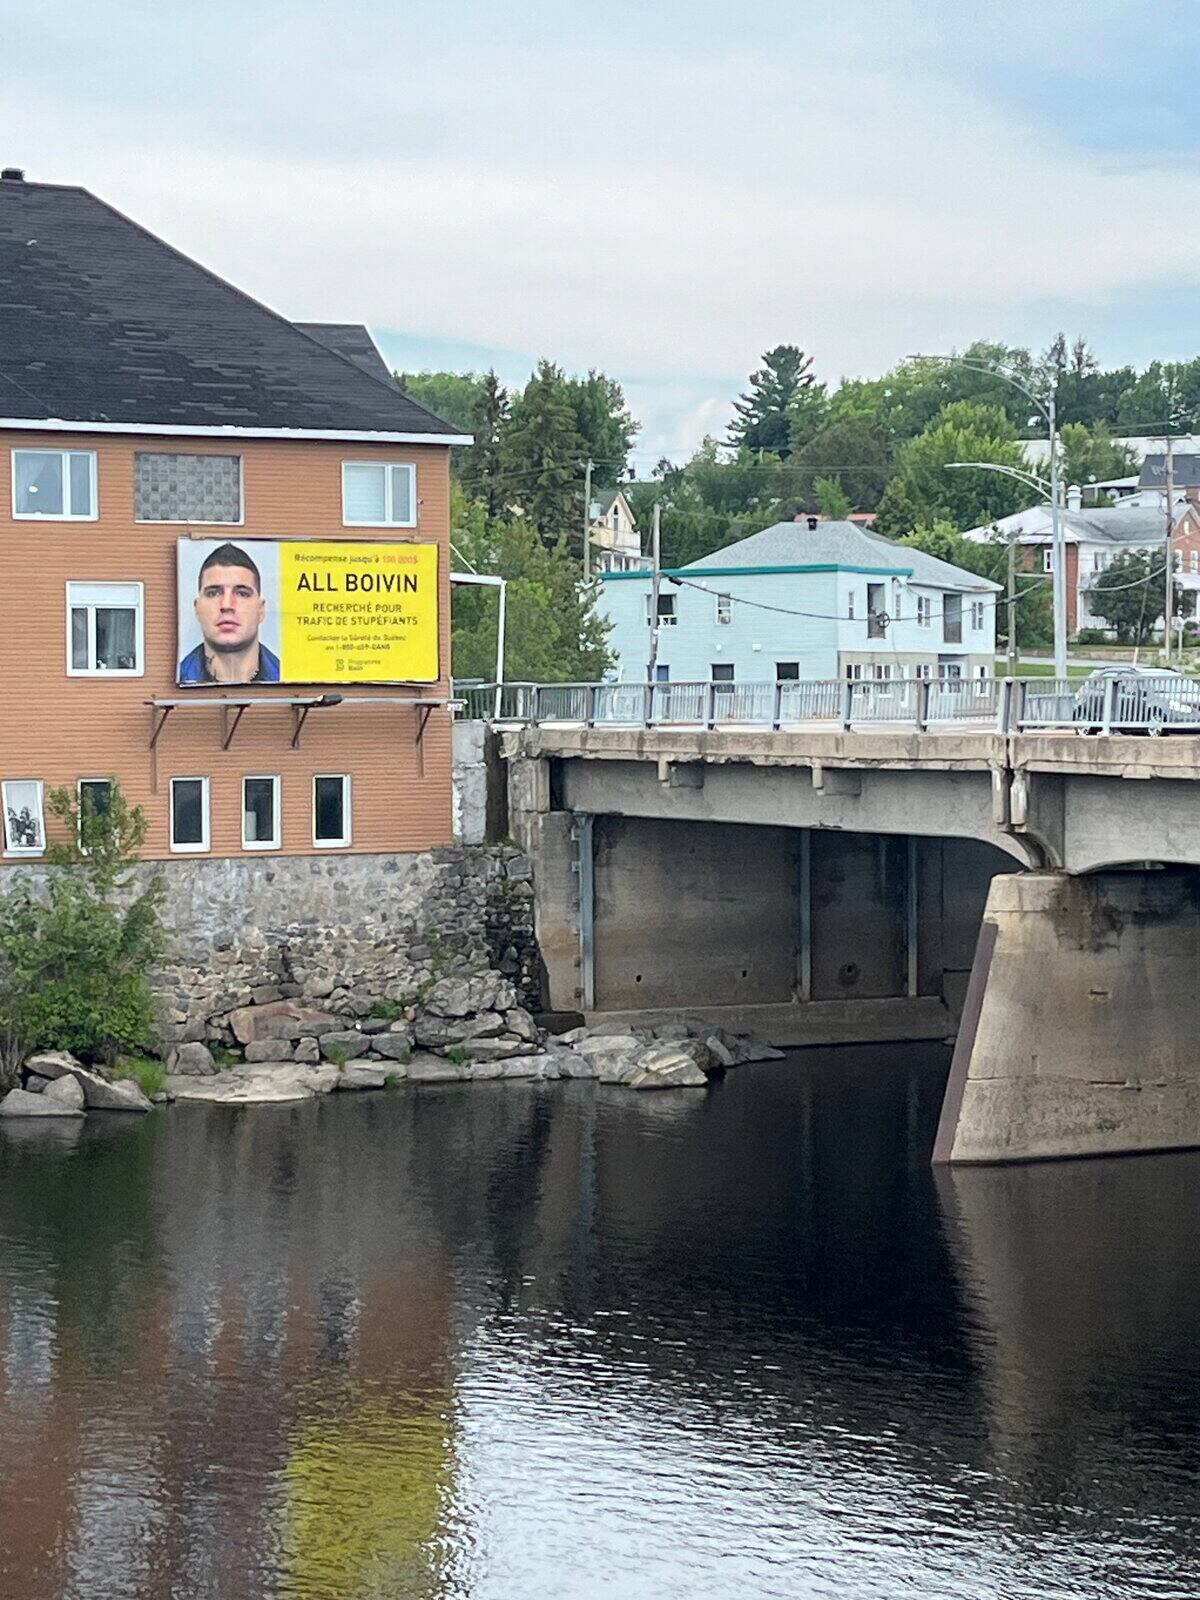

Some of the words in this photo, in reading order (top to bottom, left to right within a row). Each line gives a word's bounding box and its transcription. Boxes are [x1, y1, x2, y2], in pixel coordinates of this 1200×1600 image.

[297, 573, 338, 592] ALL
[346, 574, 417, 592] BOIVIN
[313, 602, 372, 613] RECHERCHÉ
[376, 604, 401, 613] POUR
[297, 616, 333, 625] TRAFIC
[335, 617, 347, 625] DE
[350, 615, 418, 626] STUPÉFIANTS
